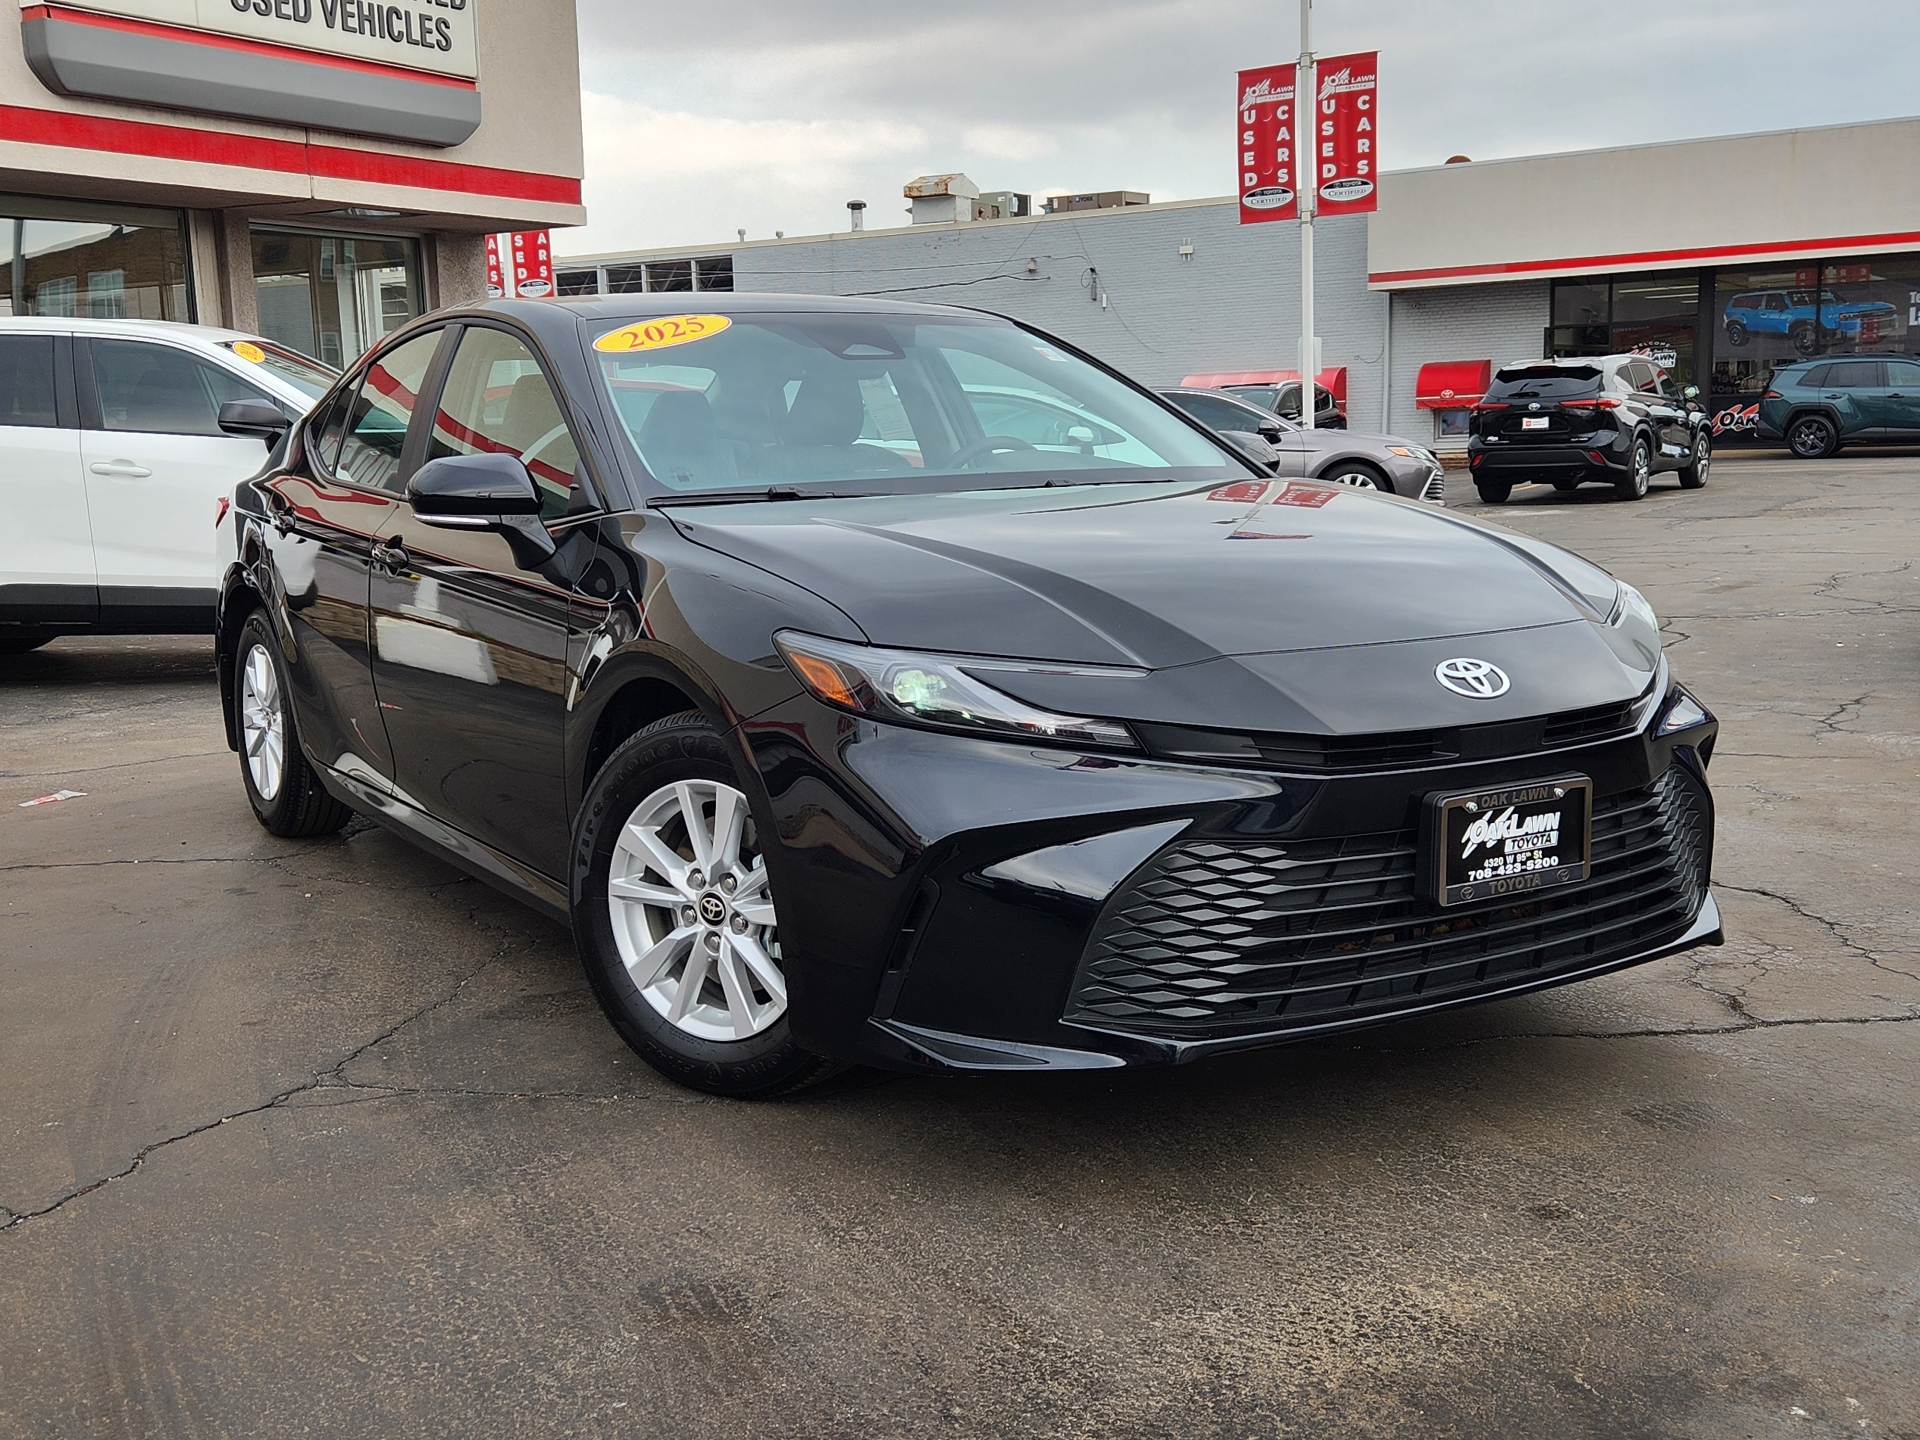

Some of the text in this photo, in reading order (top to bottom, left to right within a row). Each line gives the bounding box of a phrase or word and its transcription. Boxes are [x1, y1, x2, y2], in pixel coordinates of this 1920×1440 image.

[322, 0, 452, 52] VEHICLES
[620, 316, 705, 348] 2025
[1481, 786, 1549, 808] OAK LAWN
[1511, 833, 1553, 850] TOYOTA
[1467, 855, 1559, 882] 708-423-5200
[1483, 856, 1504, 868] 4320
[1505, 854, 1514, 864] W
[1533, 850, 1543, 860] St
[1488, 874, 1542, 894] TOYOTA
